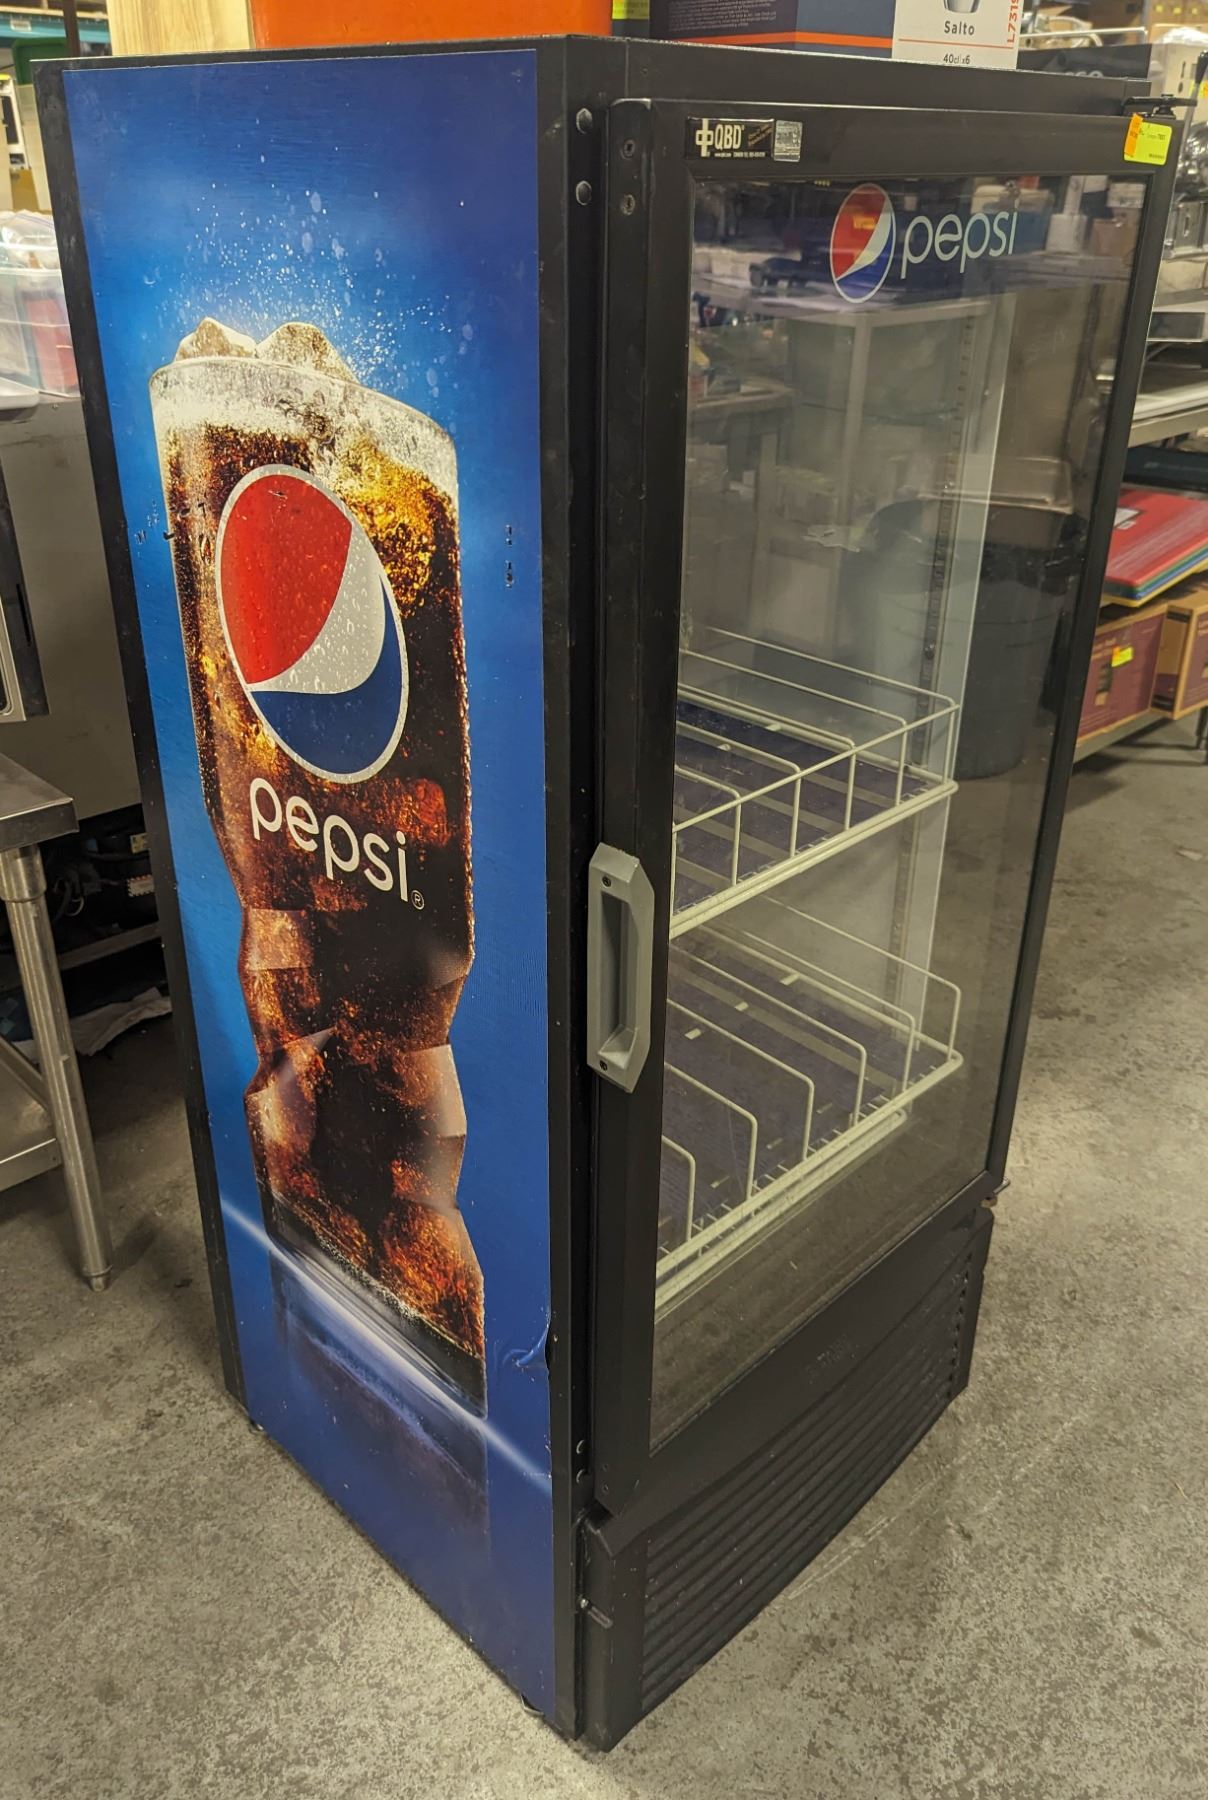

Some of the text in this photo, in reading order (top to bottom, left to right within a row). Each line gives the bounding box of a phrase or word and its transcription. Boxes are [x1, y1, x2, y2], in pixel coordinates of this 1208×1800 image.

[944, 20, 975, 36] Salto
[714, 123, 742, 150] QBD
[900, 199, 1019, 279] pepsi
[250, 777, 408, 902] pepsi
